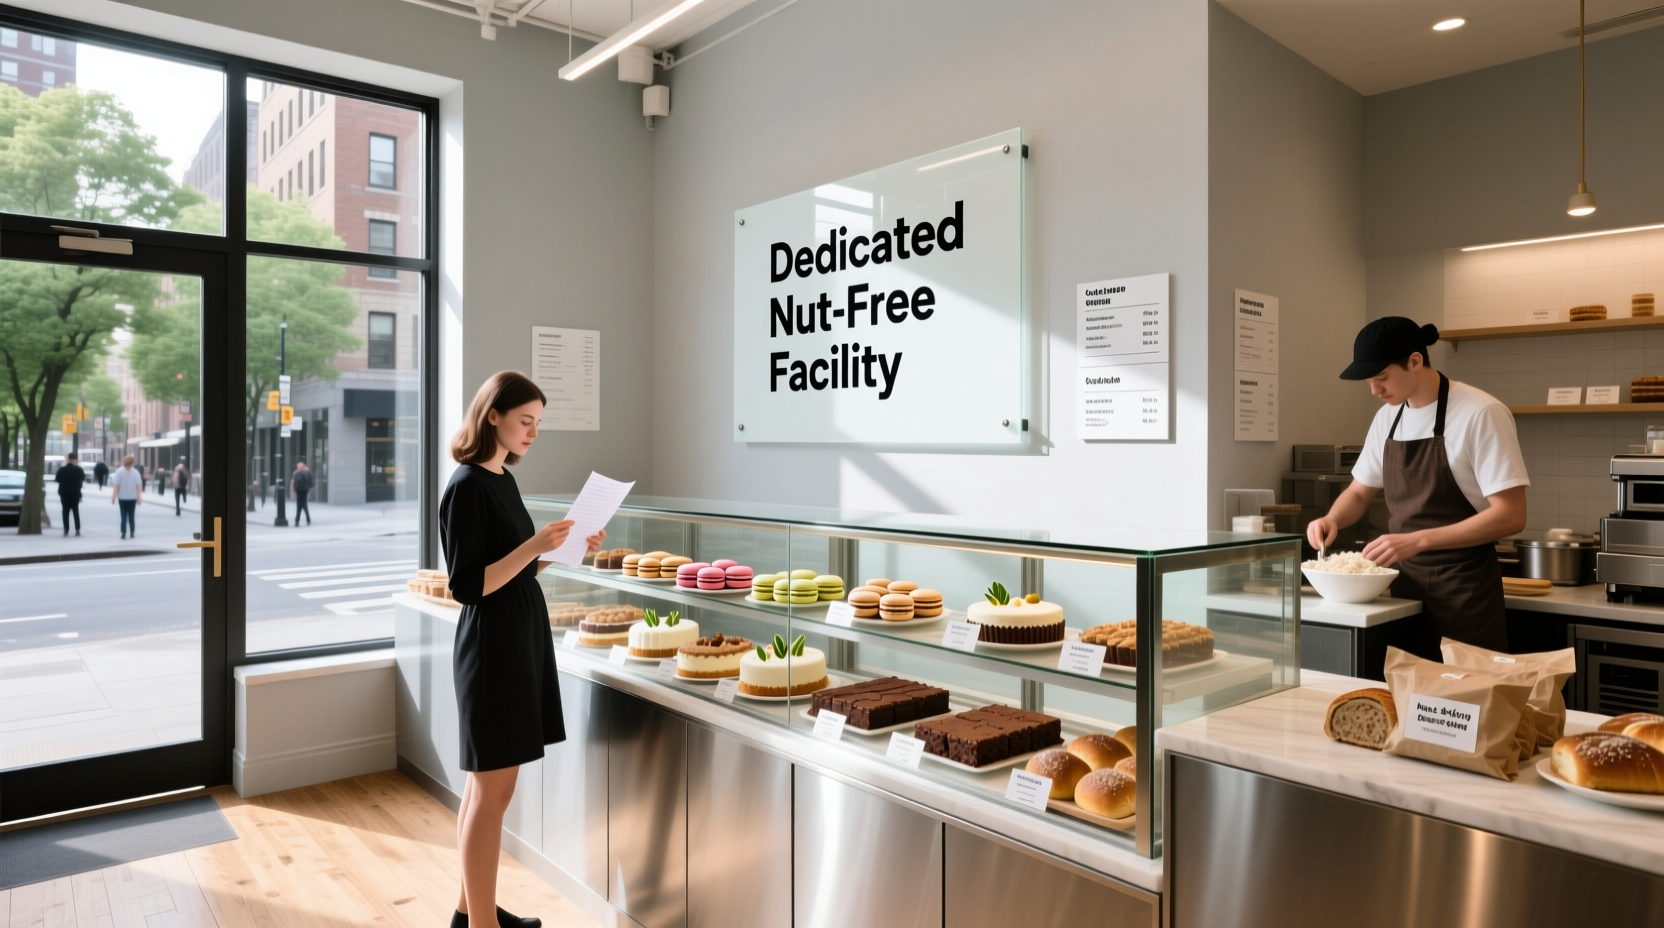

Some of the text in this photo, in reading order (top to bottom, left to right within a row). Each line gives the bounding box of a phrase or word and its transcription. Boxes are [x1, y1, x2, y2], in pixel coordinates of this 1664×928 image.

[770, 199, 964, 284] Dedicated
[770, 283, 936, 338] Nut-Free
[770, 342, 903, 400] Facility
